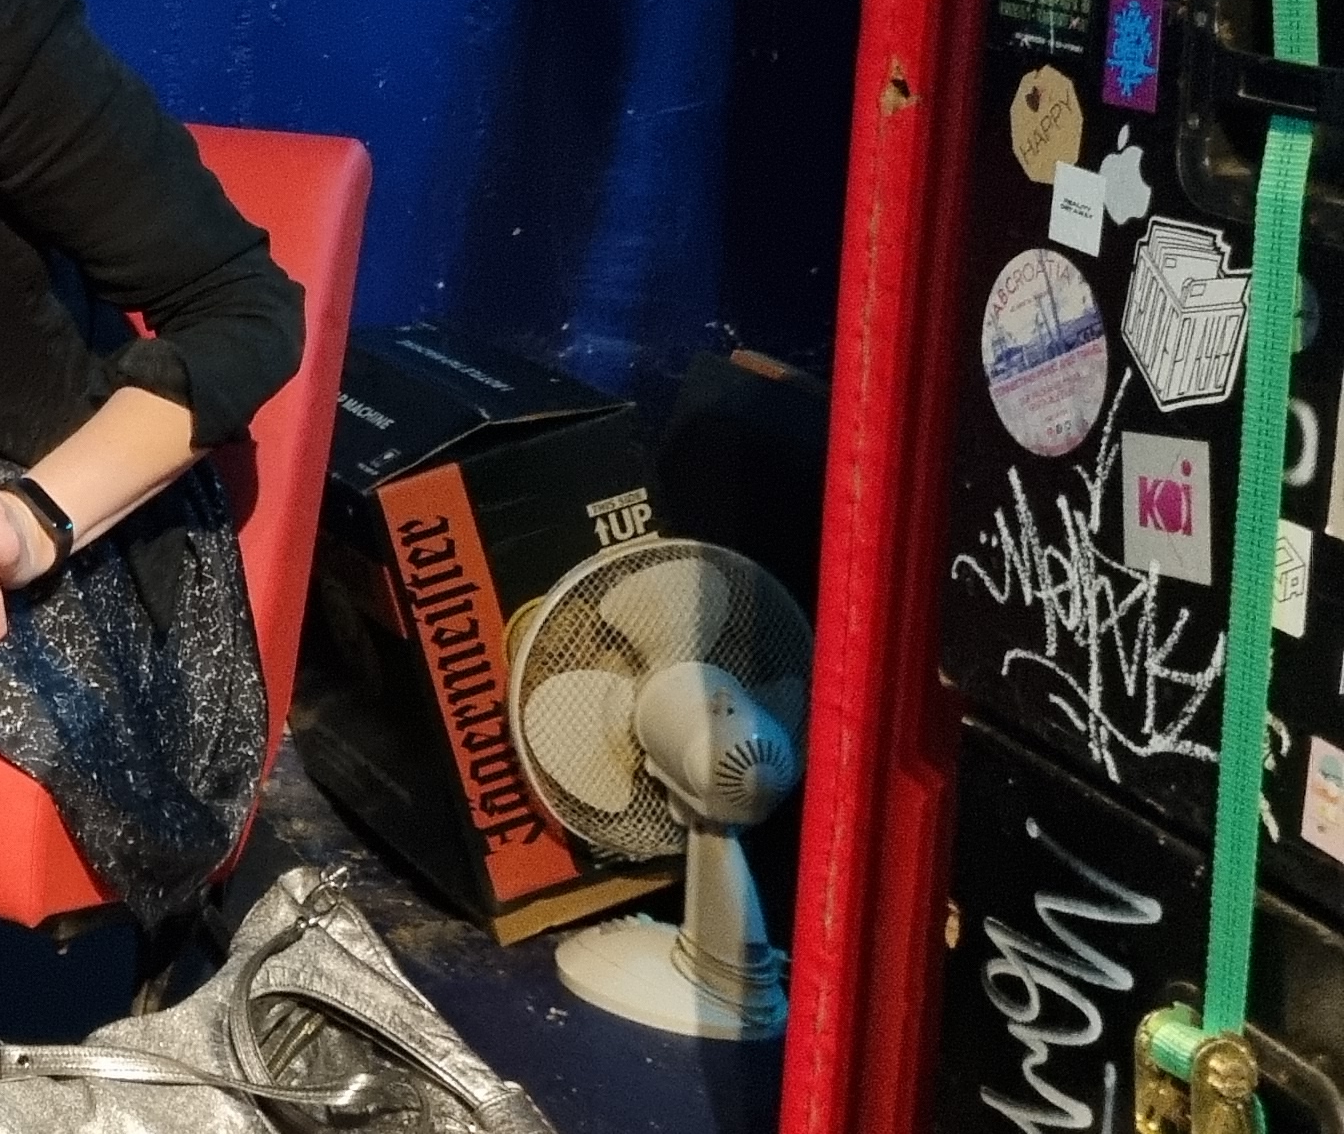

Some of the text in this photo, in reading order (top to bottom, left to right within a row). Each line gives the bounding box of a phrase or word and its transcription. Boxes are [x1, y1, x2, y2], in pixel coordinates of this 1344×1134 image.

[1019, 89, 1072, 165] HAPPY
[341, 397, 396, 430] MACHINE
[607, 503, 653, 541] UP
[397, 515, 546, 854] Jägermeister
